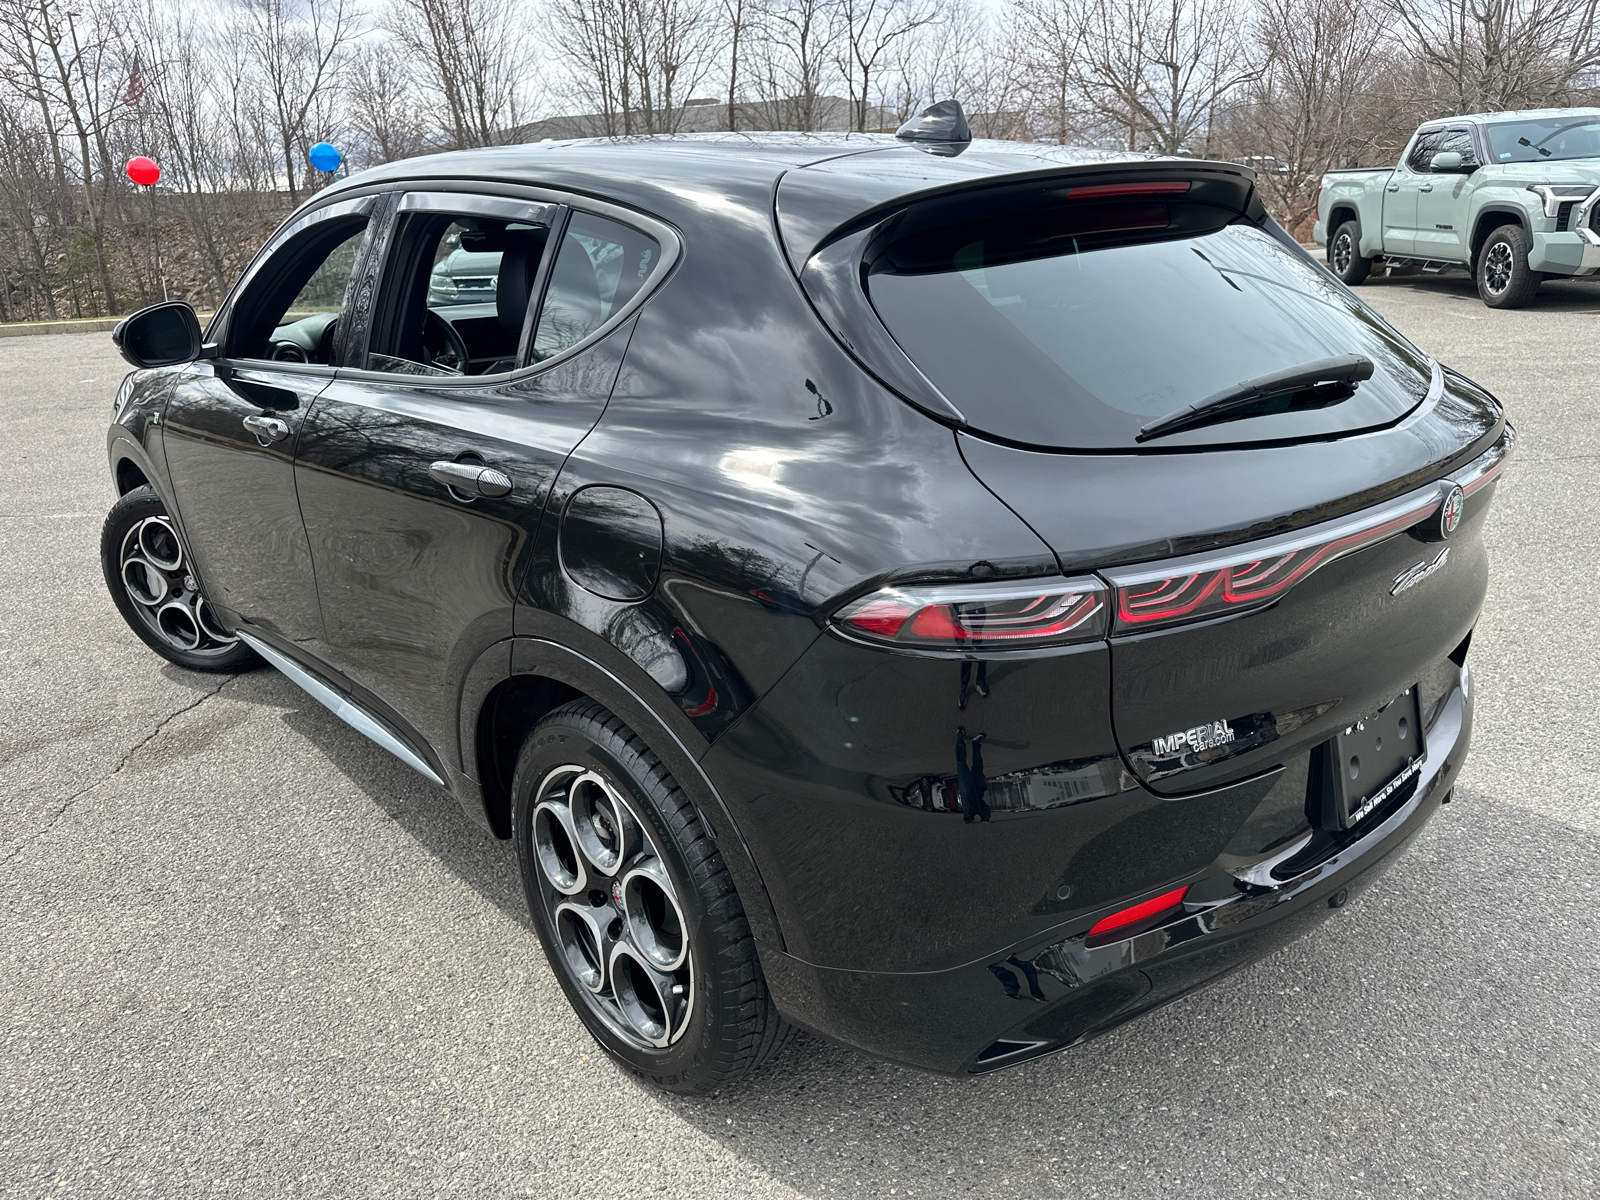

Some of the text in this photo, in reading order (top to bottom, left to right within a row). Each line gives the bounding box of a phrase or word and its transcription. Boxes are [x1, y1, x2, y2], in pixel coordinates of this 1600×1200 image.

[1152, 718, 1234, 756] IMPERIAL
[1193, 732, 1235, 753] cars.com
[1355, 811, 1364, 822] We
